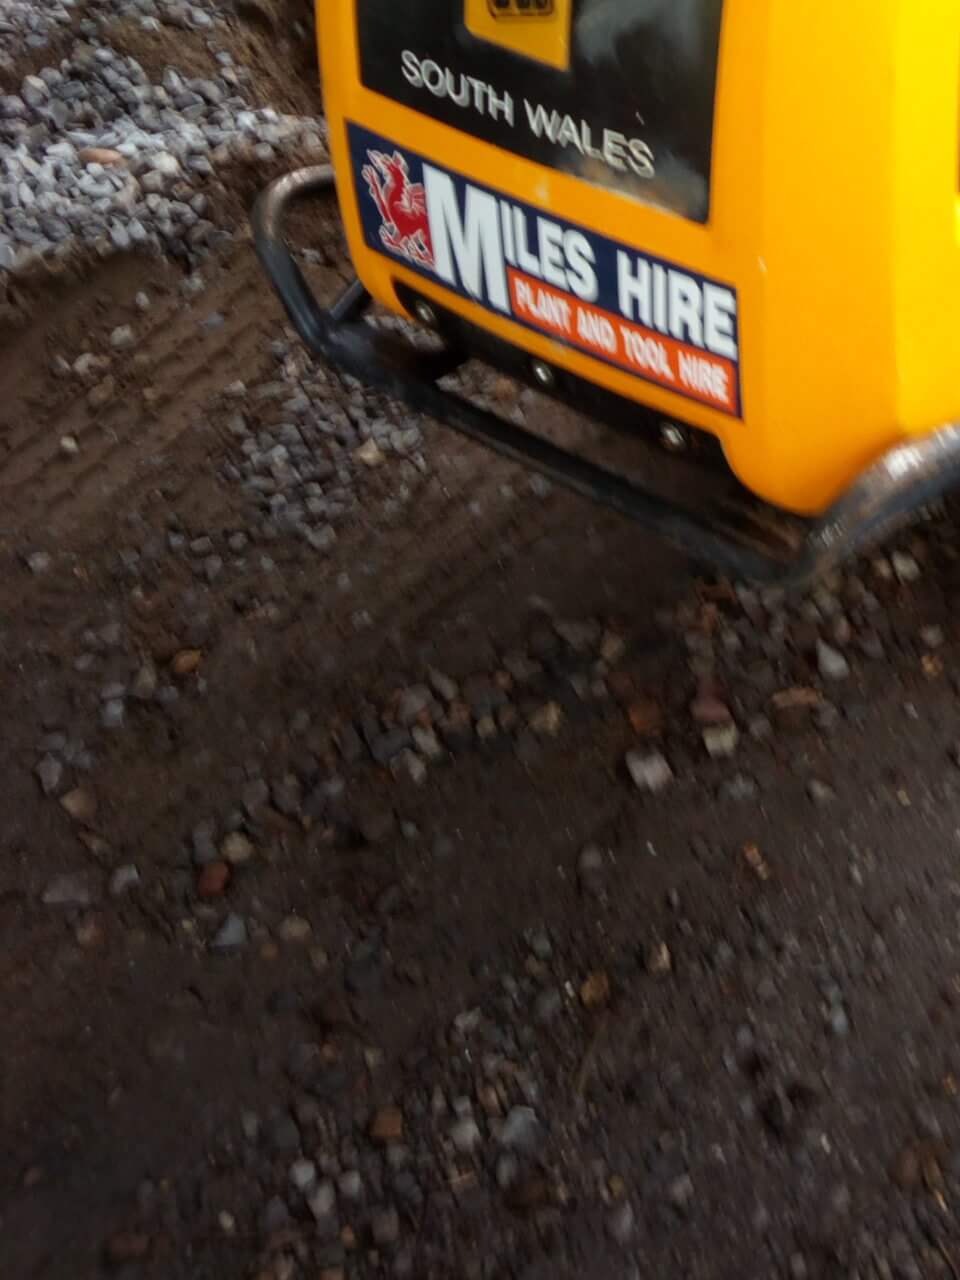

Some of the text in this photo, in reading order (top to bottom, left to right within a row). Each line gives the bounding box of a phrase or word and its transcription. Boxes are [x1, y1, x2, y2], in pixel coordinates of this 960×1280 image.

[400, 49, 655, 179] SOUTH WALES
[422, 162, 739, 362] MILES HIRE
[513, 277, 729, 404] PLANT AND TOOL HIRE
